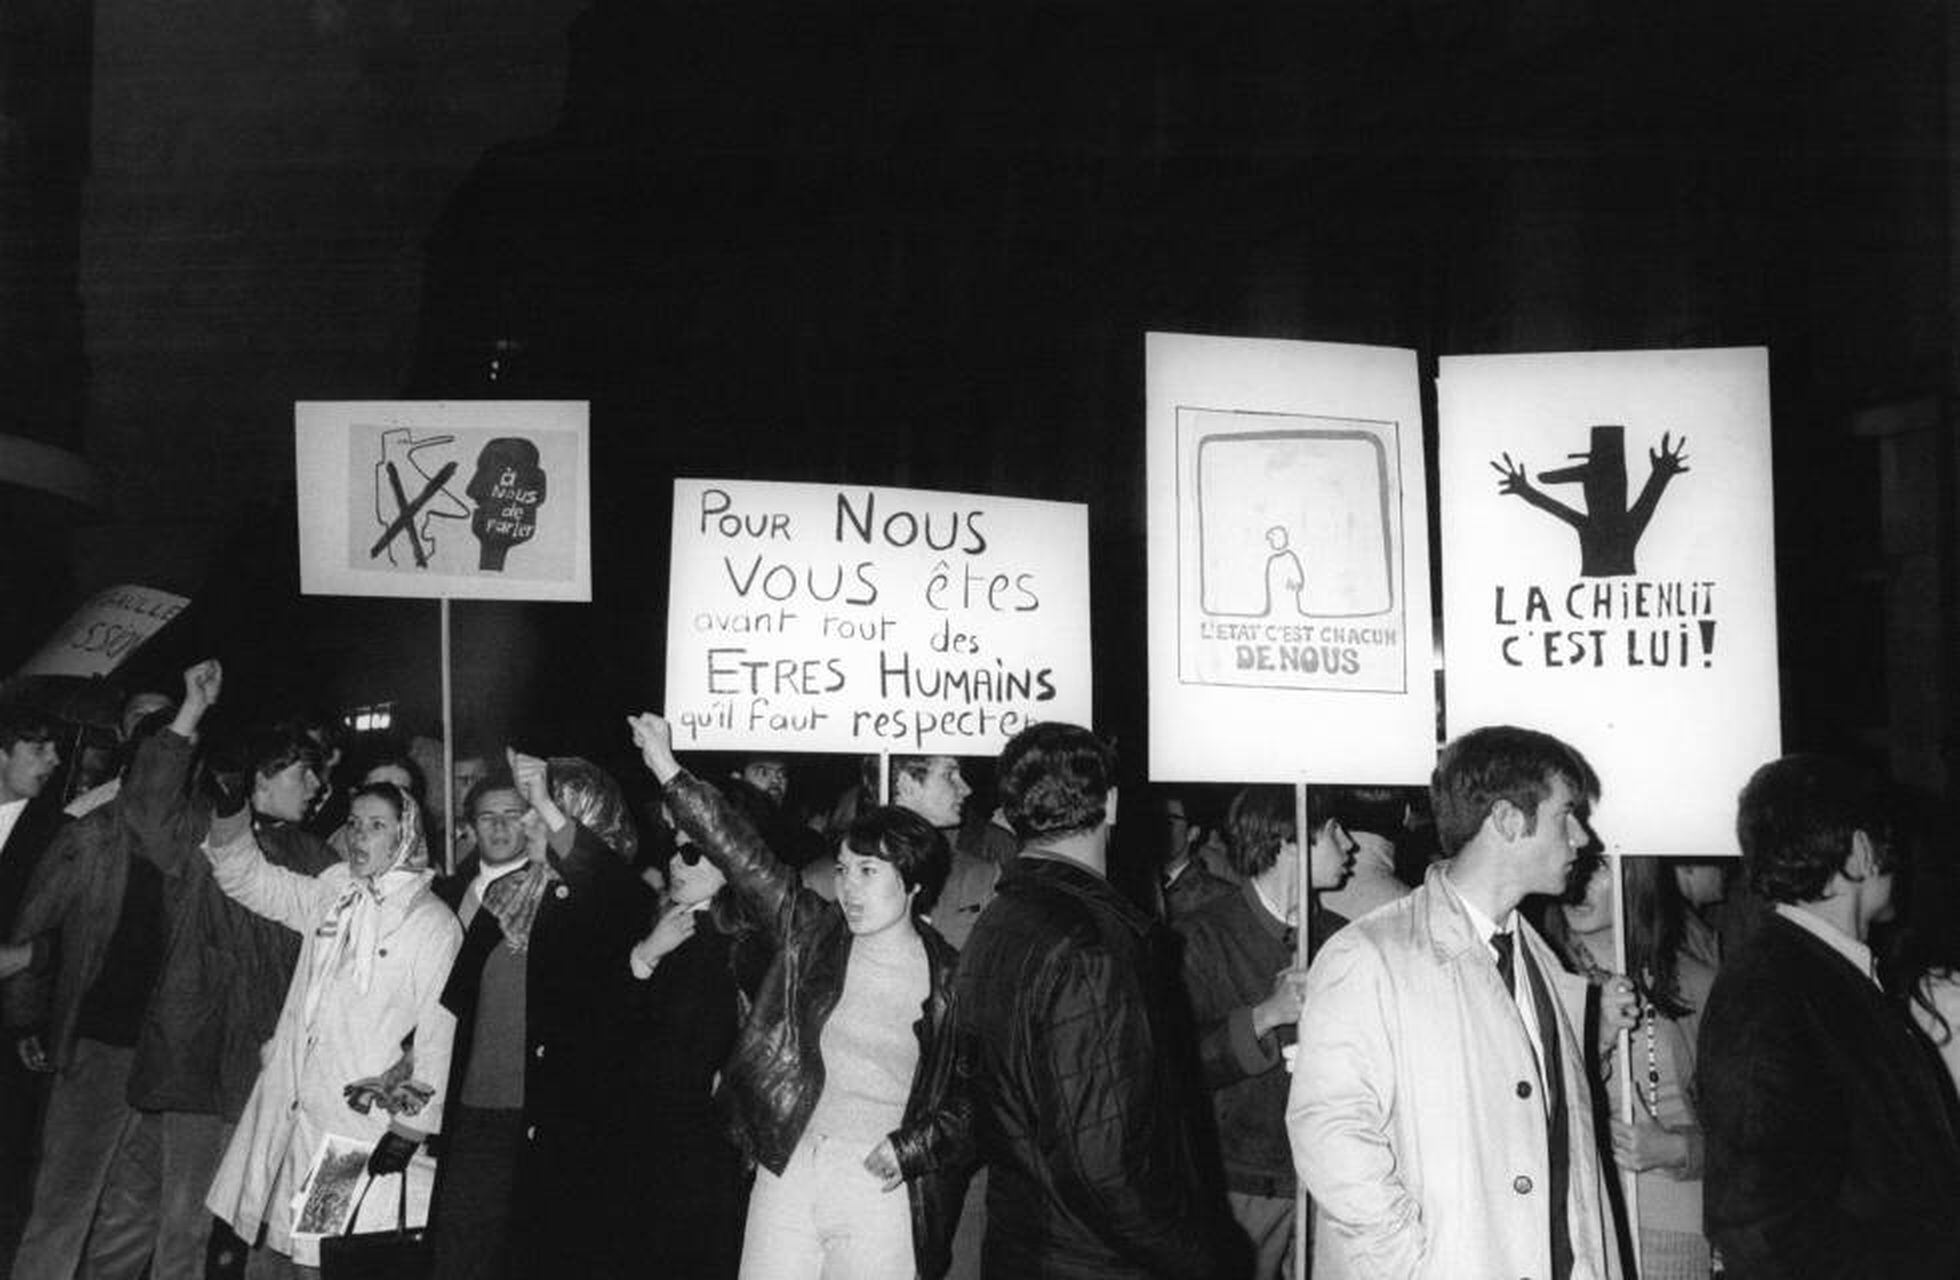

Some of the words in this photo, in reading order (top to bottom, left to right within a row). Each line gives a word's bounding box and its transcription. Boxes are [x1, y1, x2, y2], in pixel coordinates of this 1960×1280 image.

[835, 491, 987, 555] NOUS
[723, 554, 878, 607] VOUS
[925, 559, 1040, 612] êtes
[1494, 585, 1553, 626] LA
[694, 606, 799, 634] avant
[823, 615, 897, 642] tout
[930, 618, 980, 655] des
[1502, 629, 1608, 668] C'EST
[707, 647, 846, 696] ETRES
[1235, 644, 1275, 672] DE
[1279, 644, 1361, 675] NOUS
[749, 698, 828, 731] faut
